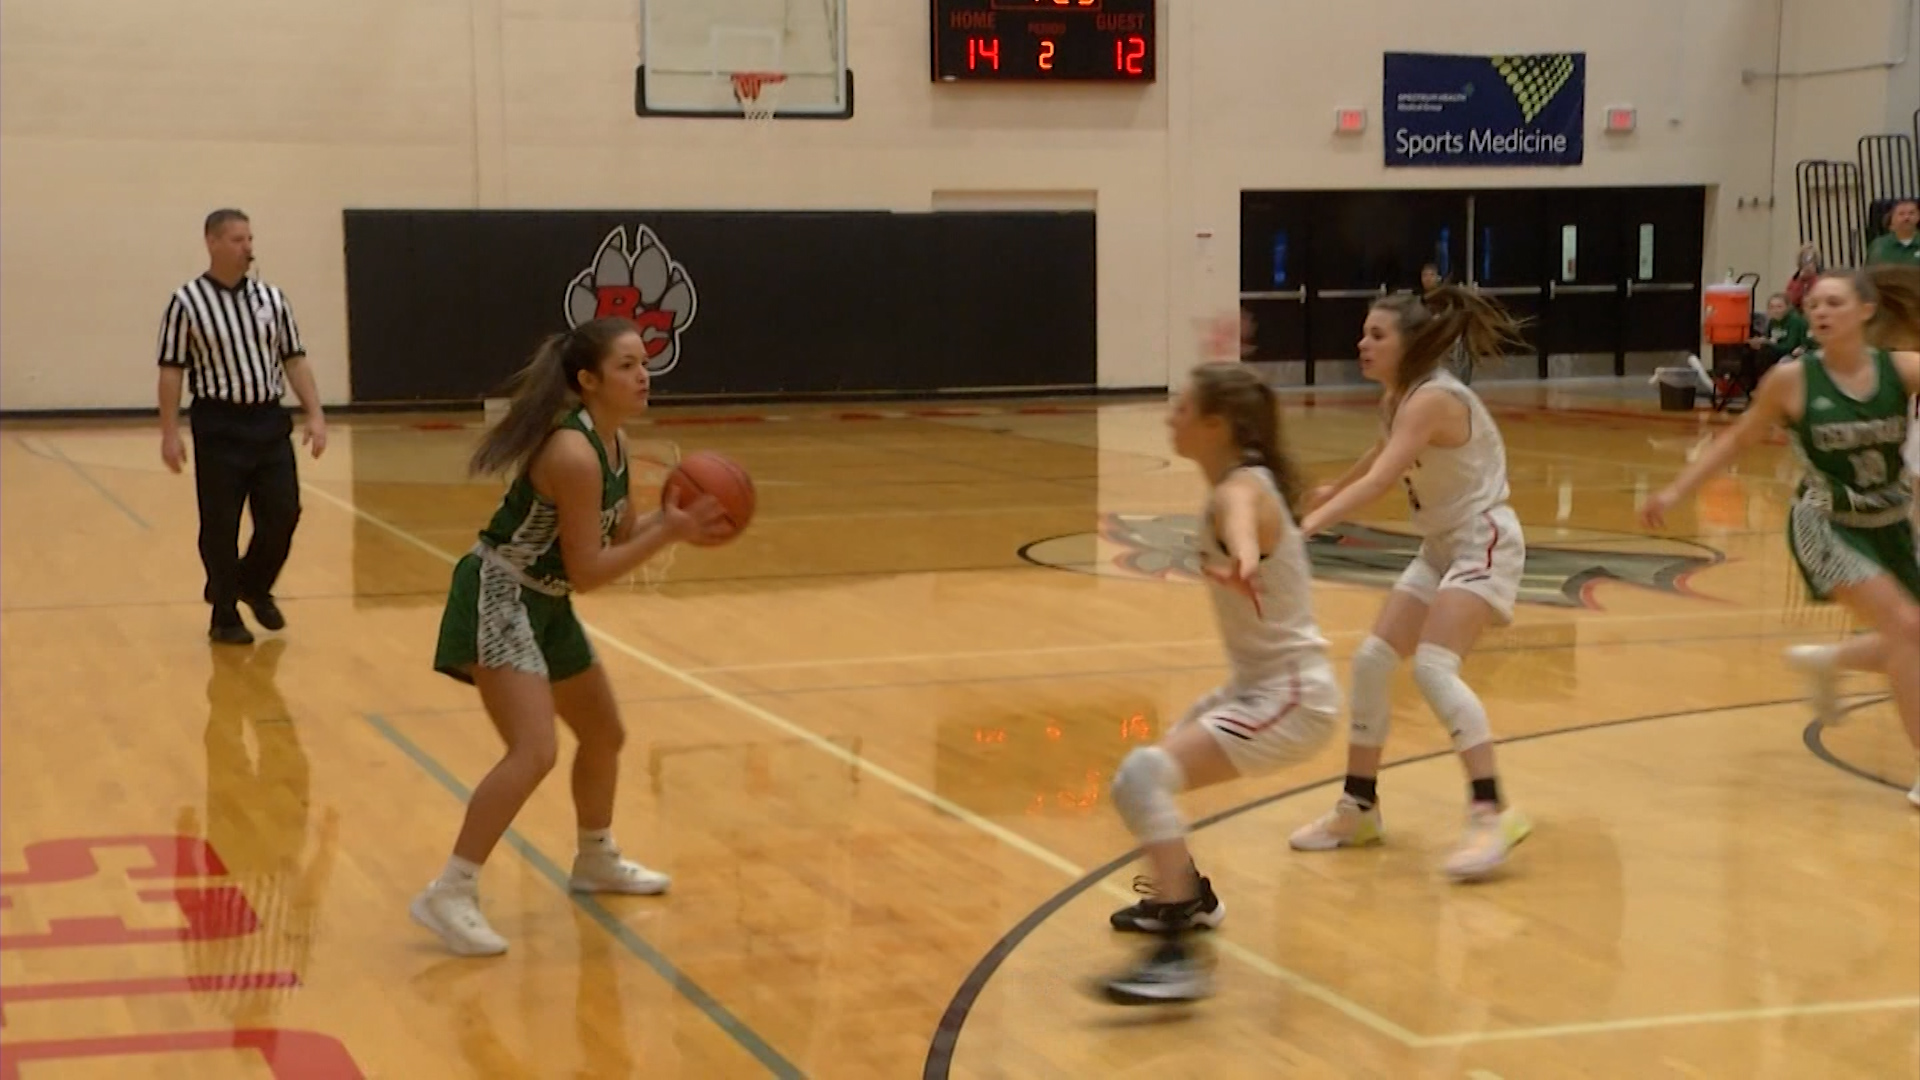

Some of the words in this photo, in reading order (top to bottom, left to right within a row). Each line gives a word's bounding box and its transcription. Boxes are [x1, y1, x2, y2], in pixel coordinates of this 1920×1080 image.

[951, 13, 997, 29] HOME
[1096, 13, 1145, 31] GUEST
[969, 38, 999, 70] 14
[1038, 40, 1055, 70] 2
[1116, 37, 1146, 74] 12
[1395, 127, 1463, 159] Sports
[1469, 128, 1567, 153] Medicine
